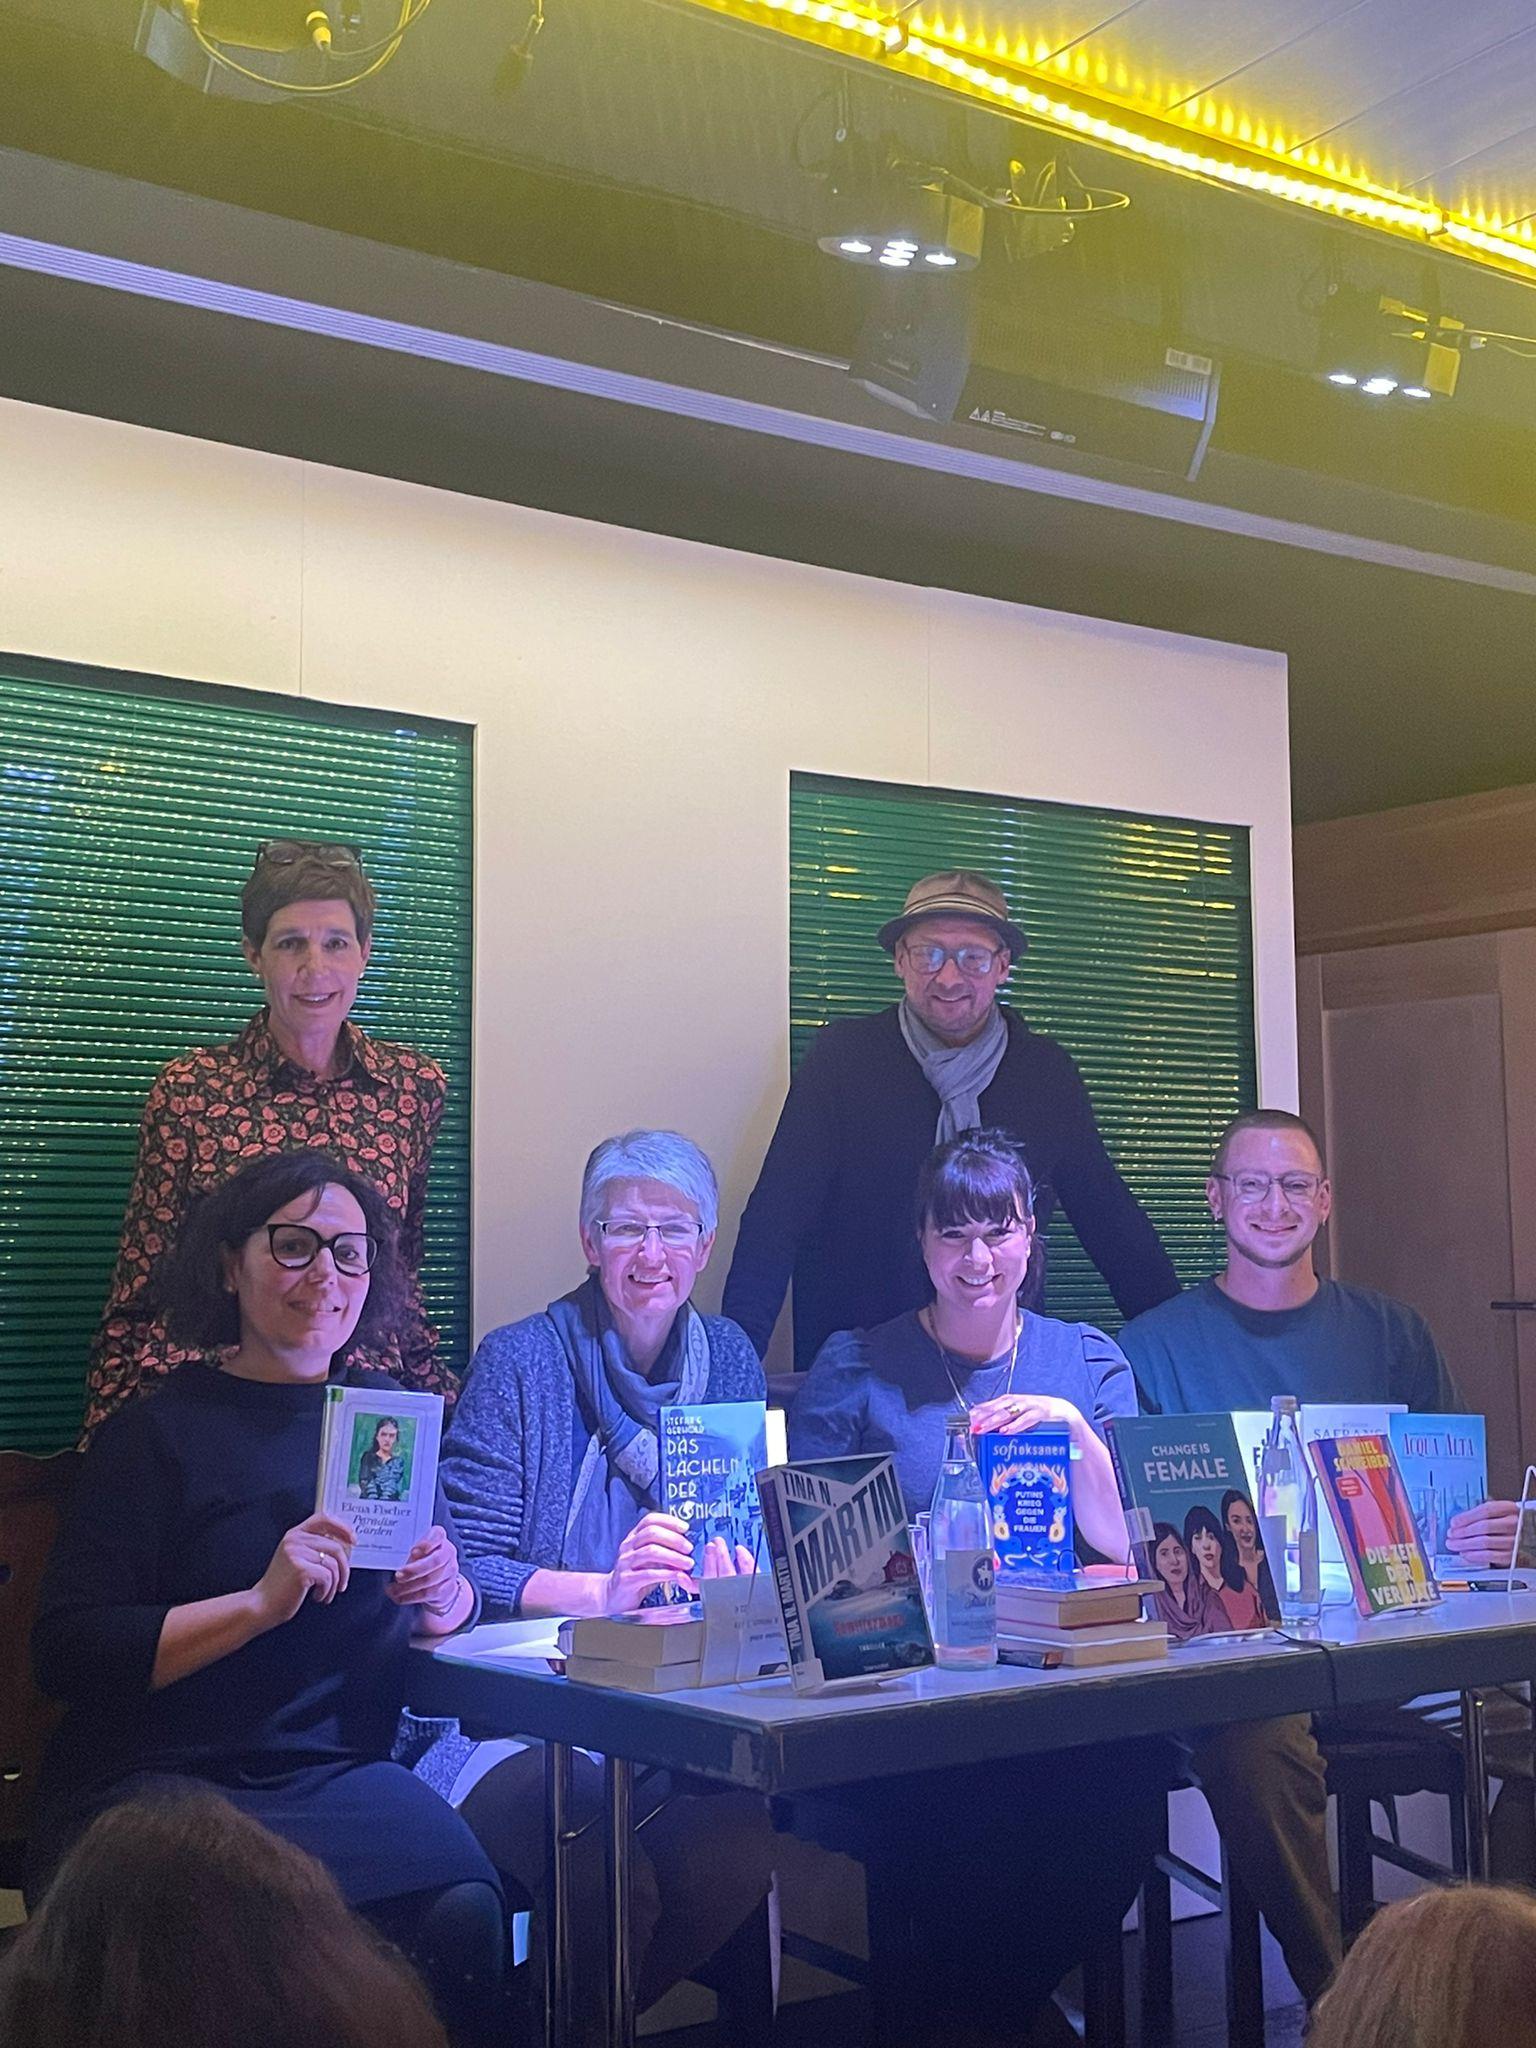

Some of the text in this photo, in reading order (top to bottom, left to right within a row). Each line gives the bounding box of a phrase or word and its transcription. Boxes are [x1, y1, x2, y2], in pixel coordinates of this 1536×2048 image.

[667, 1437, 699, 1455] DAS
[1151, 1443, 1211, 1457] CHANGE IS
[1143, 1458, 1229, 1482] FEMALE
[668, 1479, 698, 1499] DER
[781, 1471, 837, 1508] TINA N.
[1015, 1490, 1044, 1499] PUTINS
[341, 1502, 412, 1517] Elena Fischer
[1015, 1508, 1045, 1516] GEGEN
[1017, 1499, 1042, 1508] KRIEG
[1013, 1524, 1047, 1533] FRAUEN
[1022, 1516, 1038, 1524] DIE
[794, 1464, 904, 1604] MARTIN
[1365, 1546, 1391, 1565] DIE
[775, 1556, 795, 1604] MARTIN
[787, 1617, 802, 1650] TINA
